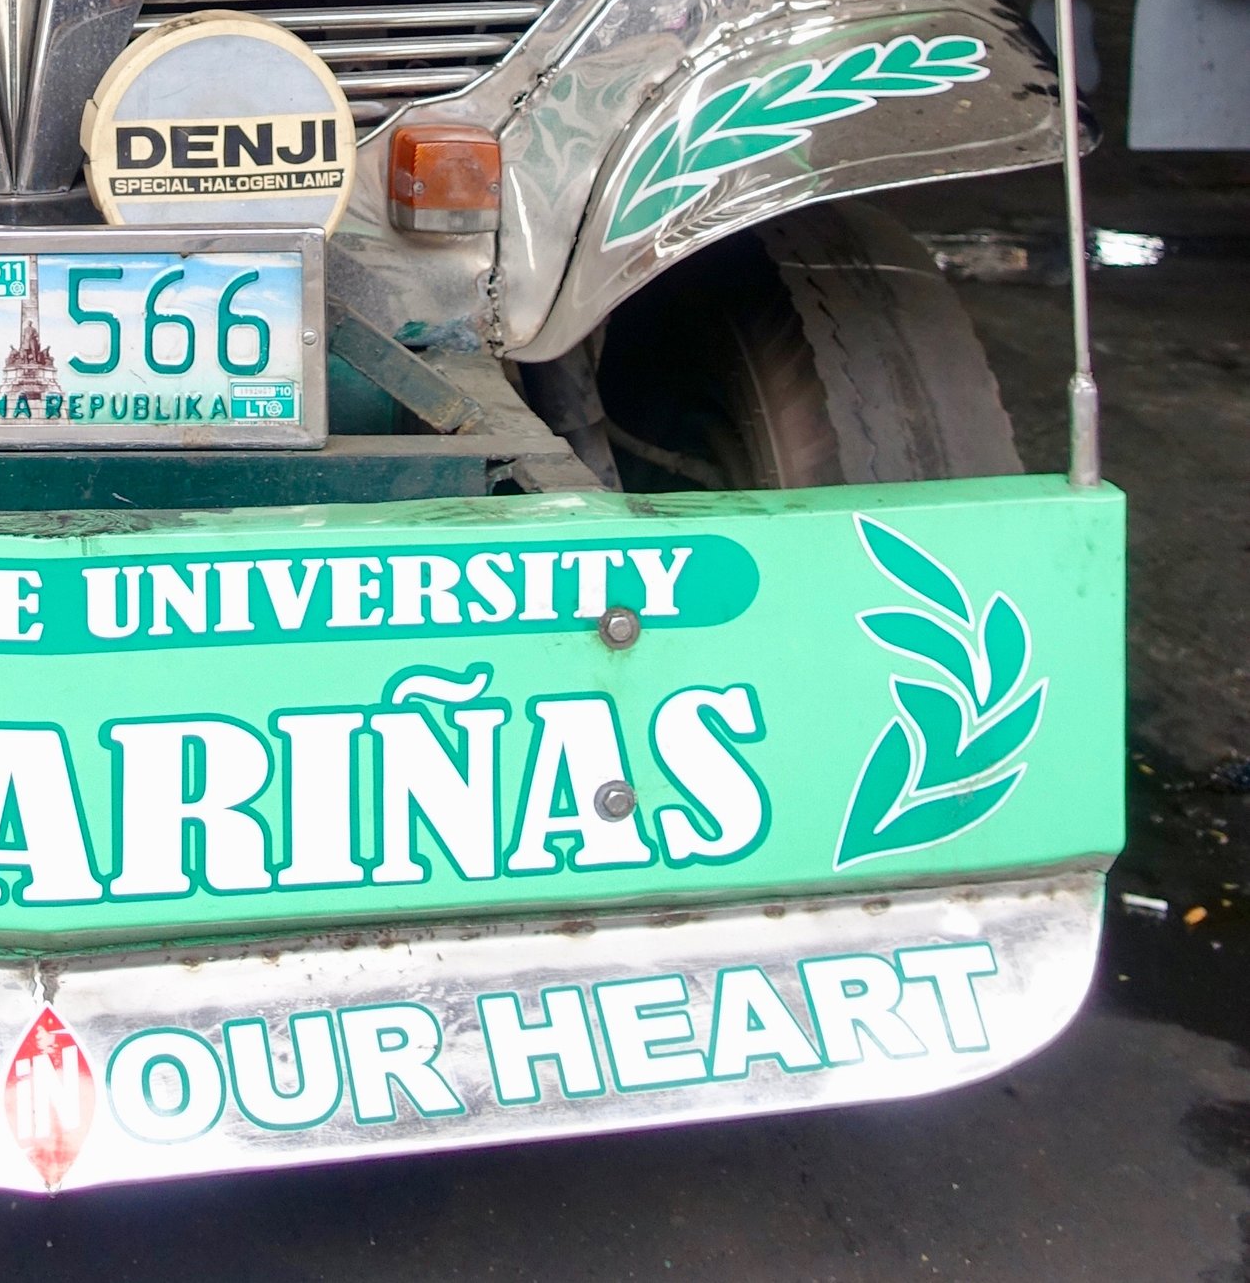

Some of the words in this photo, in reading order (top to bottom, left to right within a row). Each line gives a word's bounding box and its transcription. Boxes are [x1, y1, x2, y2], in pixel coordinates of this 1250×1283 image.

[115, 119, 338, 170] DENJI
[114, 177, 195, 194] SPECIAL
[199, 174, 289, 193] HALOGEN
[291, 172, 342, 189] LAMP
[67, 265, 271, 377] 566
[43, 391, 229, 422] REPUBLIKA
[81, 546, 693, 640] UNIVERSITY
[105, 1000, 467, 1146] OUR
[476, 941, 998, 1105] HEART
